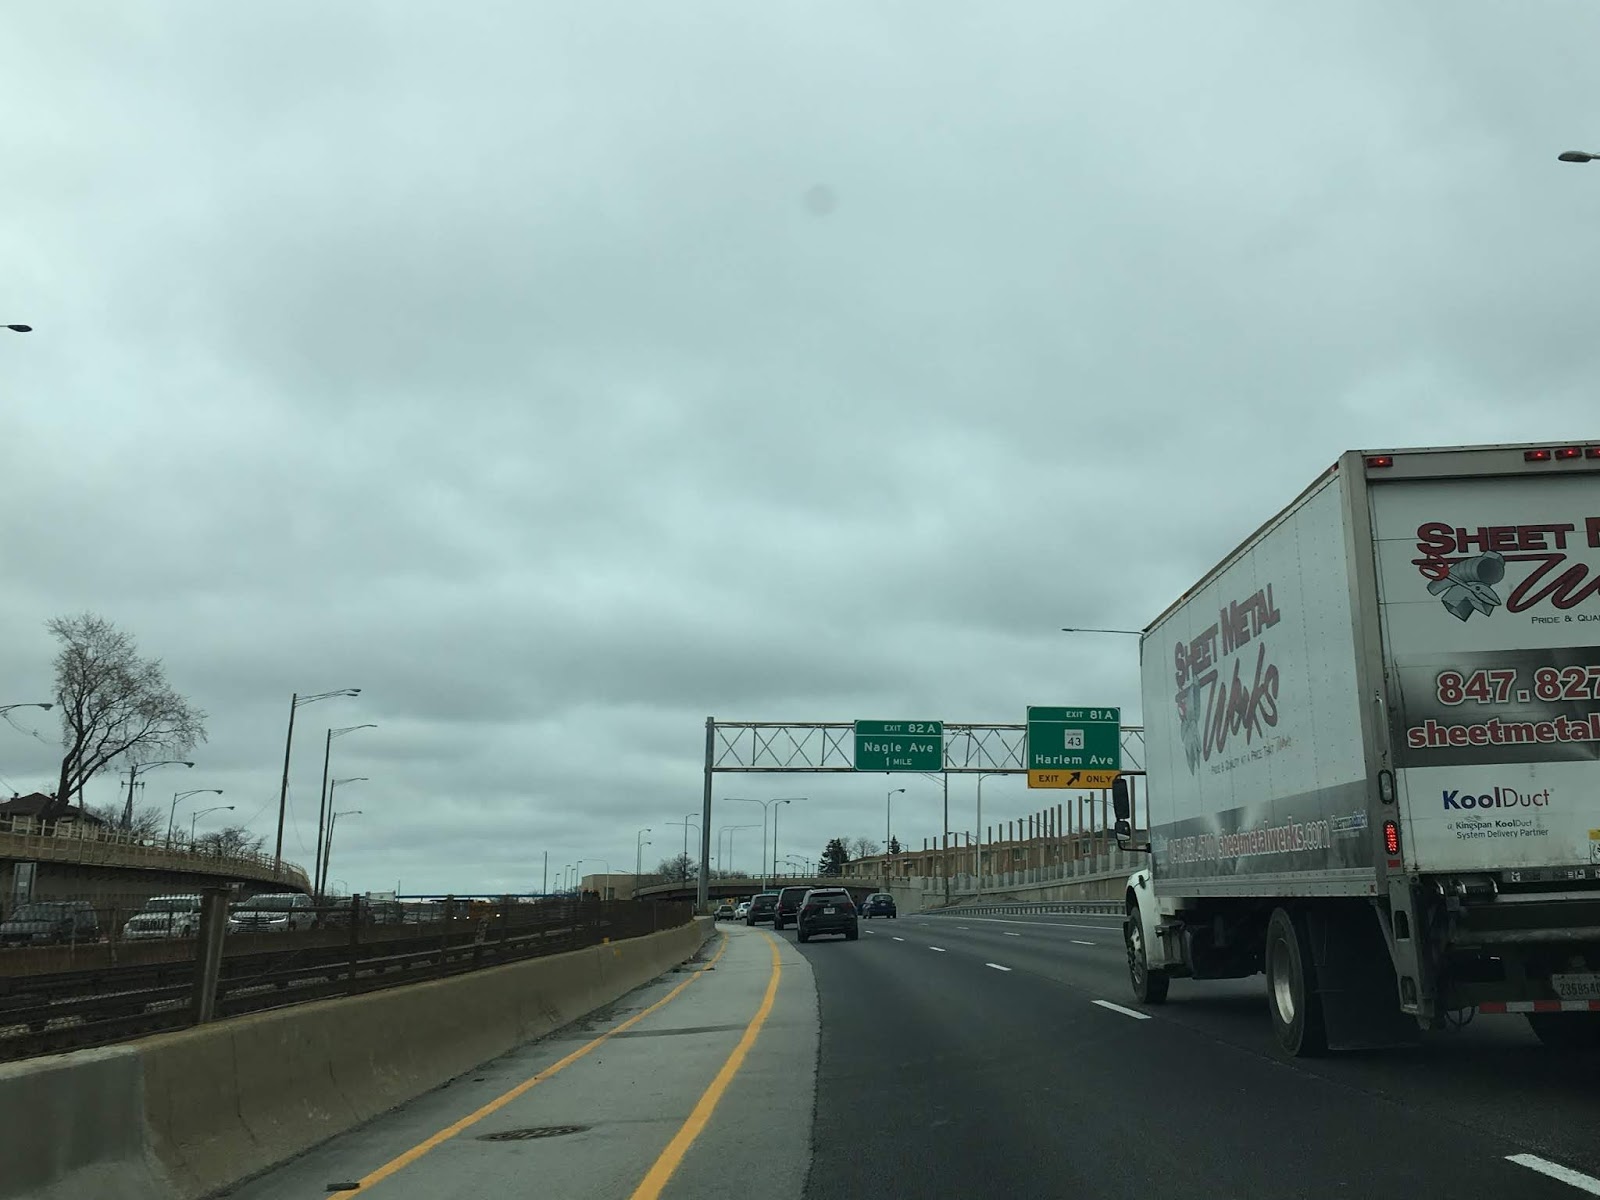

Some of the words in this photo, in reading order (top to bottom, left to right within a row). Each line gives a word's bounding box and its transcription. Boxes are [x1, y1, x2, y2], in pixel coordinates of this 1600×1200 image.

[1416, 522, 1575, 555] SHEET
[1531, 616, 1560, 624] PRIDE
[1564, 614, 1572, 623] &
[1174, 622, 1219, 690] SHEET
[1220, 582, 1281, 657] METAL
[884, 724, 901, 732] EXIT
[1407, 713, 1600, 748] sheetmetal
[1067, 737, 1082, 747] 43
[864, 742, 902, 755] Nagle
[909, 742, 934, 752] Ave
[885, 757, 890, 766] 1
[1035, 754, 1082, 764] Harlem
[1089, 754, 1114, 765] Ave
[1038, 774, 1059, 782] EXIT
[1086, 775, 1112, 783] ONLY
[1442, 786, 1550, 810] KoolDuct
[1456, 821, 1492, 831] Kingspan
[1495, 819, 1532, 828] KoolDuct
[1456, 831, 1486, 840] System
[1487, 829, 1518, 838] Delivery
[1520, 828, 1549, 837] Partner
